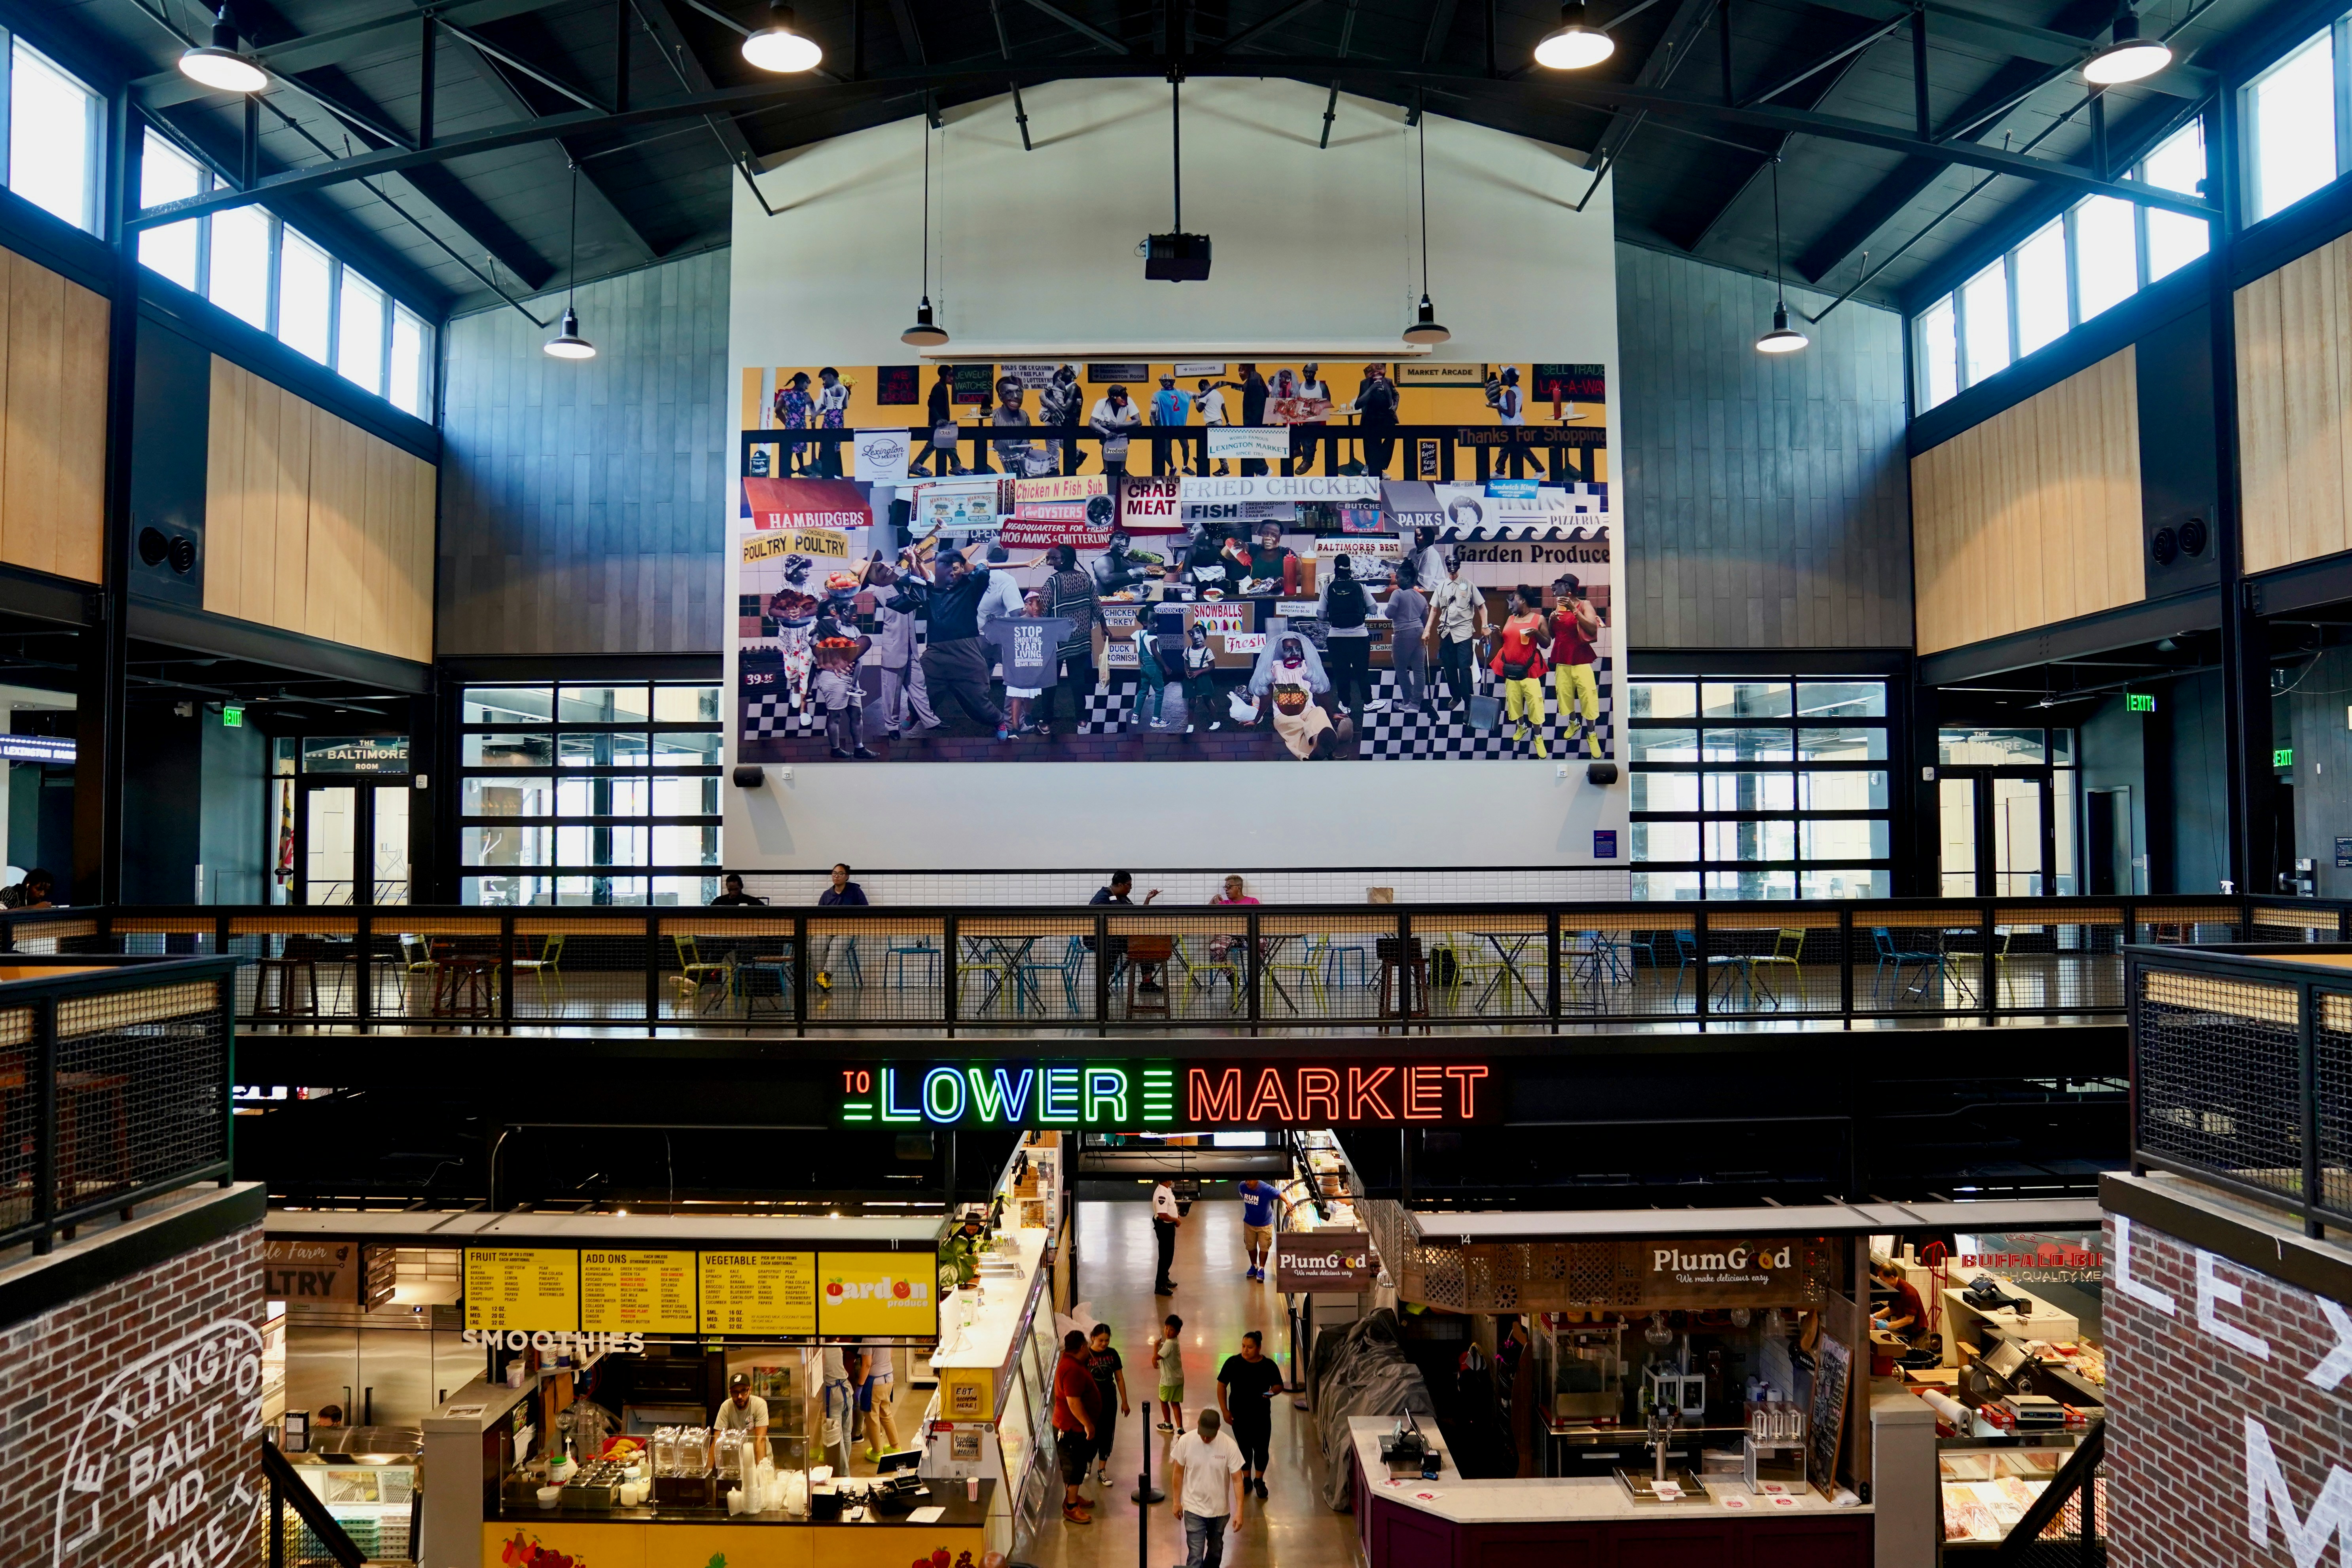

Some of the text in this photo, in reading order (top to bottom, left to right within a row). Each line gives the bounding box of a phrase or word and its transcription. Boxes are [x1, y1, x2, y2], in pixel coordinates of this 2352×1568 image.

[893, 371, 908, 380] WE
[956, 371, 993, 379] JEWELRY
[1543, 364, 1605, 375] SELL TRADE
[887, 382, 910, 391] BUY
[955, 381, 993, 390] WATCHES
[1539, 379, 1605, 394] LAY-A-WAY
[883, 392, 915, 401] GOLD
[1171, 396, 1180, 412] 2
[1458, 427, 1606, 446] Thanks For Shopping
[862, 444, 905, 460] Lexington
[1209, 442, 1288, 455] LEXINGTON MARKET
[1422, 449, 1435, 458] Repair
[1017, 483, 1050, 500] Chicken
[1054, 482, 1059, 497] N
[1064, 480, 1081, 496] Fish
[1088, 479, 1103, 495] Sub
[1127, 484, 1176, 498] CRAB
[1182, 477, 1379, 498] FRIED CHICKEN
[1490, 482, 1536, 492] Sandwich King
[929, 495, 992, 508] MANNING'S MANNING'S
[1127, 500, 1176, 515] MEAT
[1038, 506, 1083, 519] OYSTERS
[1191, 504, 1237, 518] FISH
[769, 511, 864, 528] HAMBURGERS
[1398, 513, 1442, 527] PARKS
[1550, 515, 1600, 525] PIZZERIA
[798, 528, 826, 537] BROOKDALE
[970, 529, 1000, 538] OPEN
[1006, 523, 1066, 532] HEADQUARTERS
[744, 536, 766, 546] BROOKDALE
[1001, 532, 1021, 543] HOG
[1022, 533, 1051, 544] MAWS
[744, 536, 787, 561] POULTRY
[795, 535, 845, 555] POULTRY
[1453, 544, 1610, 563] Garden Produce
[1195, 604, 1242, 617] SNOWBALLS
[1014, 626, 1043, 637] STOP
[1015, 642, 1043, 651] START
[1227, 634, 1266, 653] Fresh
[747, 674, 774, 685] 39.95
[2130, 695, 2151, 711] EXIT
[227, 710, 241, 726] EXIT
[4, 746, 51, 758] LEXINGTON
[1942, 741, 2022, 751] BALTIMORE
[327, 750, 407, 759] BALTIMORE
[2275, 749, 2293, 766] EXIT
[843, 1066, 1488, 1123] TO LOWER MARKET
[1244, 1193, 1259, 1202] RUN
[890, 1239, 898, 1250] 11
[1460, 1234, 1471, 1245] 14
[288, 1241, 328, 1260] Farm
[470, 1252, 497, 1261] FRUIT
[586, 1254, 627, 1264] ADD ONS
[705, 1256, 757, 1265] VEGETABLE
[1962, 1253, 2065, 1268] BUFFALO
[1676, 1273, 1769, 1285] We make delicious easy
[1976, 1271, 2019, 1283] FRESH
[2021, 1271, 2078, 1283] QUALITY
[887, 1299, 928, 1308] produce
[462, 1329, 645, 1353] SMOOTHIES
[1799, 1355, 1815, 1368] RAVENS
[129, 1402, 222, 1498] BALT
[146, 1469, 208, 1541] MD.
